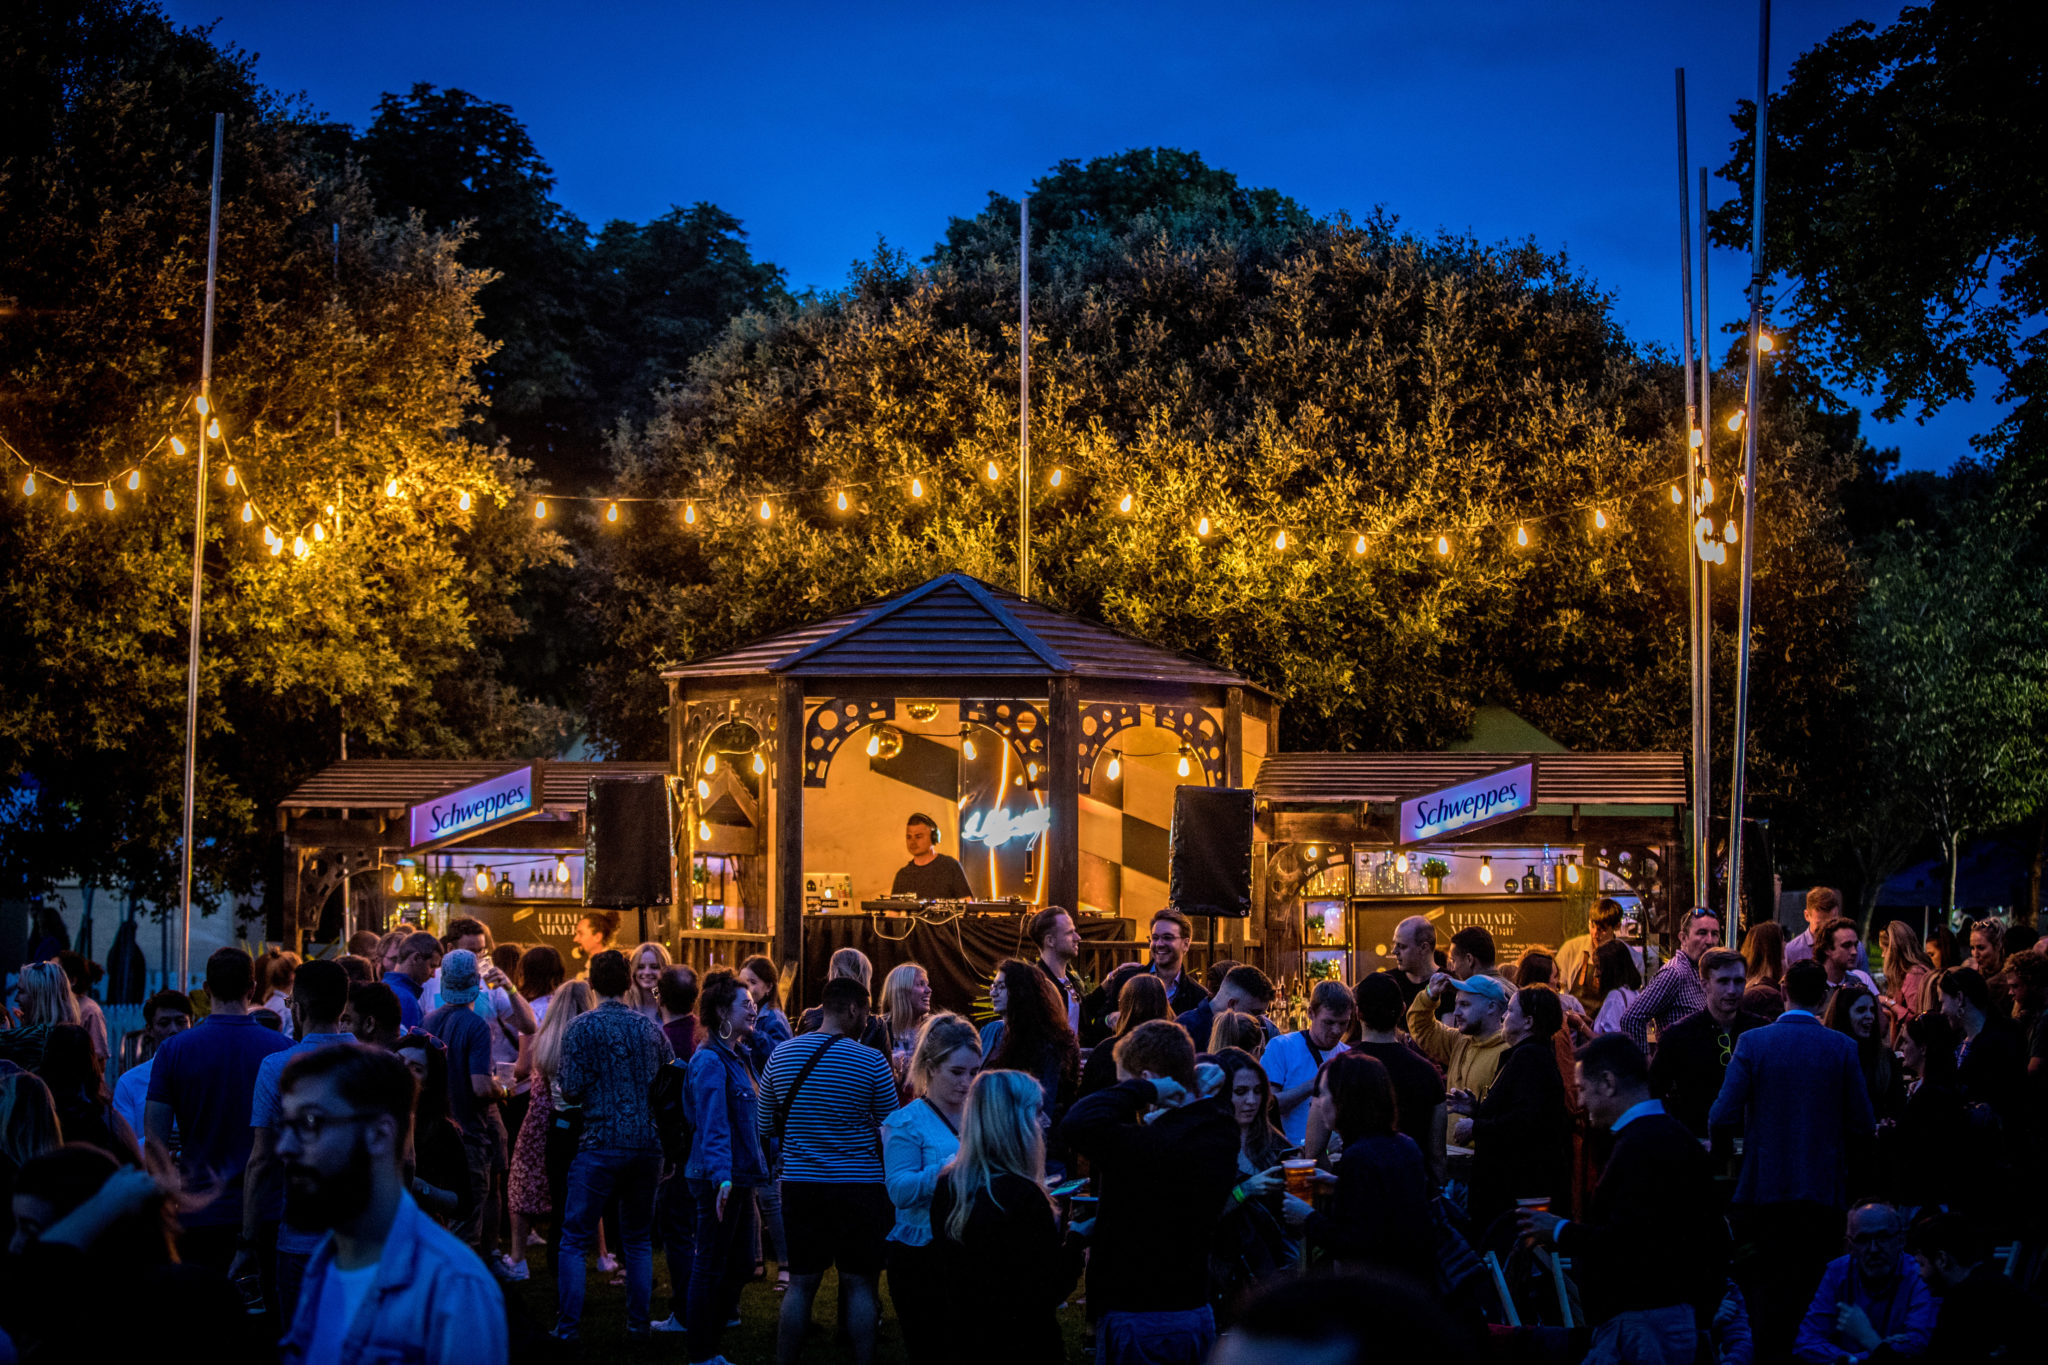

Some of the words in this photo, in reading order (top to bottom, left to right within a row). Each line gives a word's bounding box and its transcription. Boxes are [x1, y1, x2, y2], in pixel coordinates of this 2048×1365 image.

[429, 785, 524, 833] Schweppes
[1414, 783, 1518, 830] Schweppes
[538, 912, 584, 924] ULTIM
[1449, 912, 1517, 925] ULTIMATE
